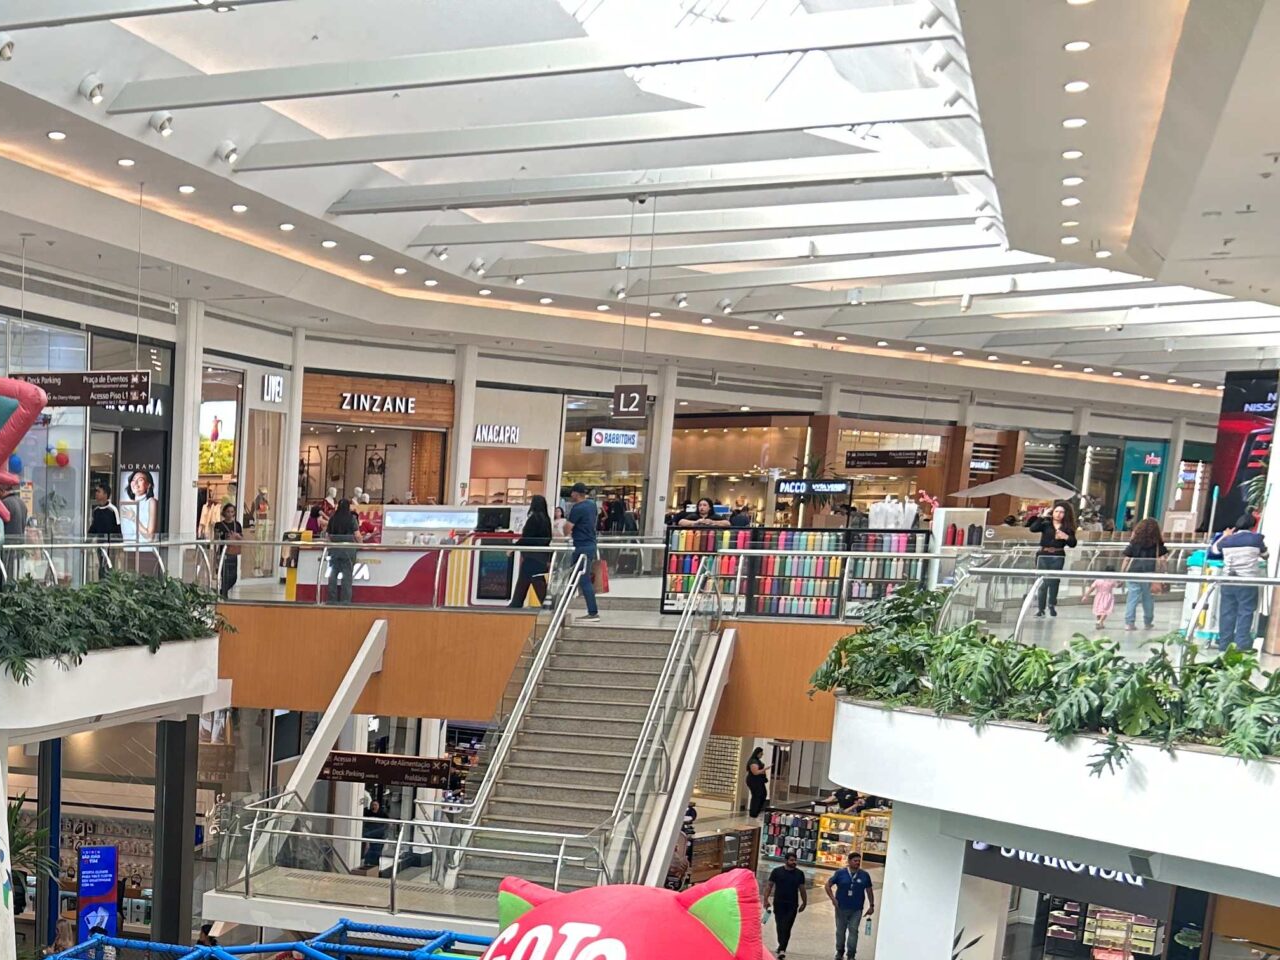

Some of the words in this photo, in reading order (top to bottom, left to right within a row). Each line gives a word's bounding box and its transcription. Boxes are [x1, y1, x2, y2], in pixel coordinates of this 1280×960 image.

[41, 376, 61, 386] Parking
[83, 375, 98, 385] Praça
[107, 375, 128, 383] Eventos
[263, 374, 283, 402] LIVE!
[90, 391, 109, 400] Acesso
[110, 391, 121, 399] Piso
[342, 393, 416, 413] ZINZANE
[619, 393, 640, 411] L2
[475, 424, 520, 444] ANACAPRI
[780, 482, 806, 493] PACCO
[332, 768, 345, 776] Deck
[345, 769, 365, 779] Parking
